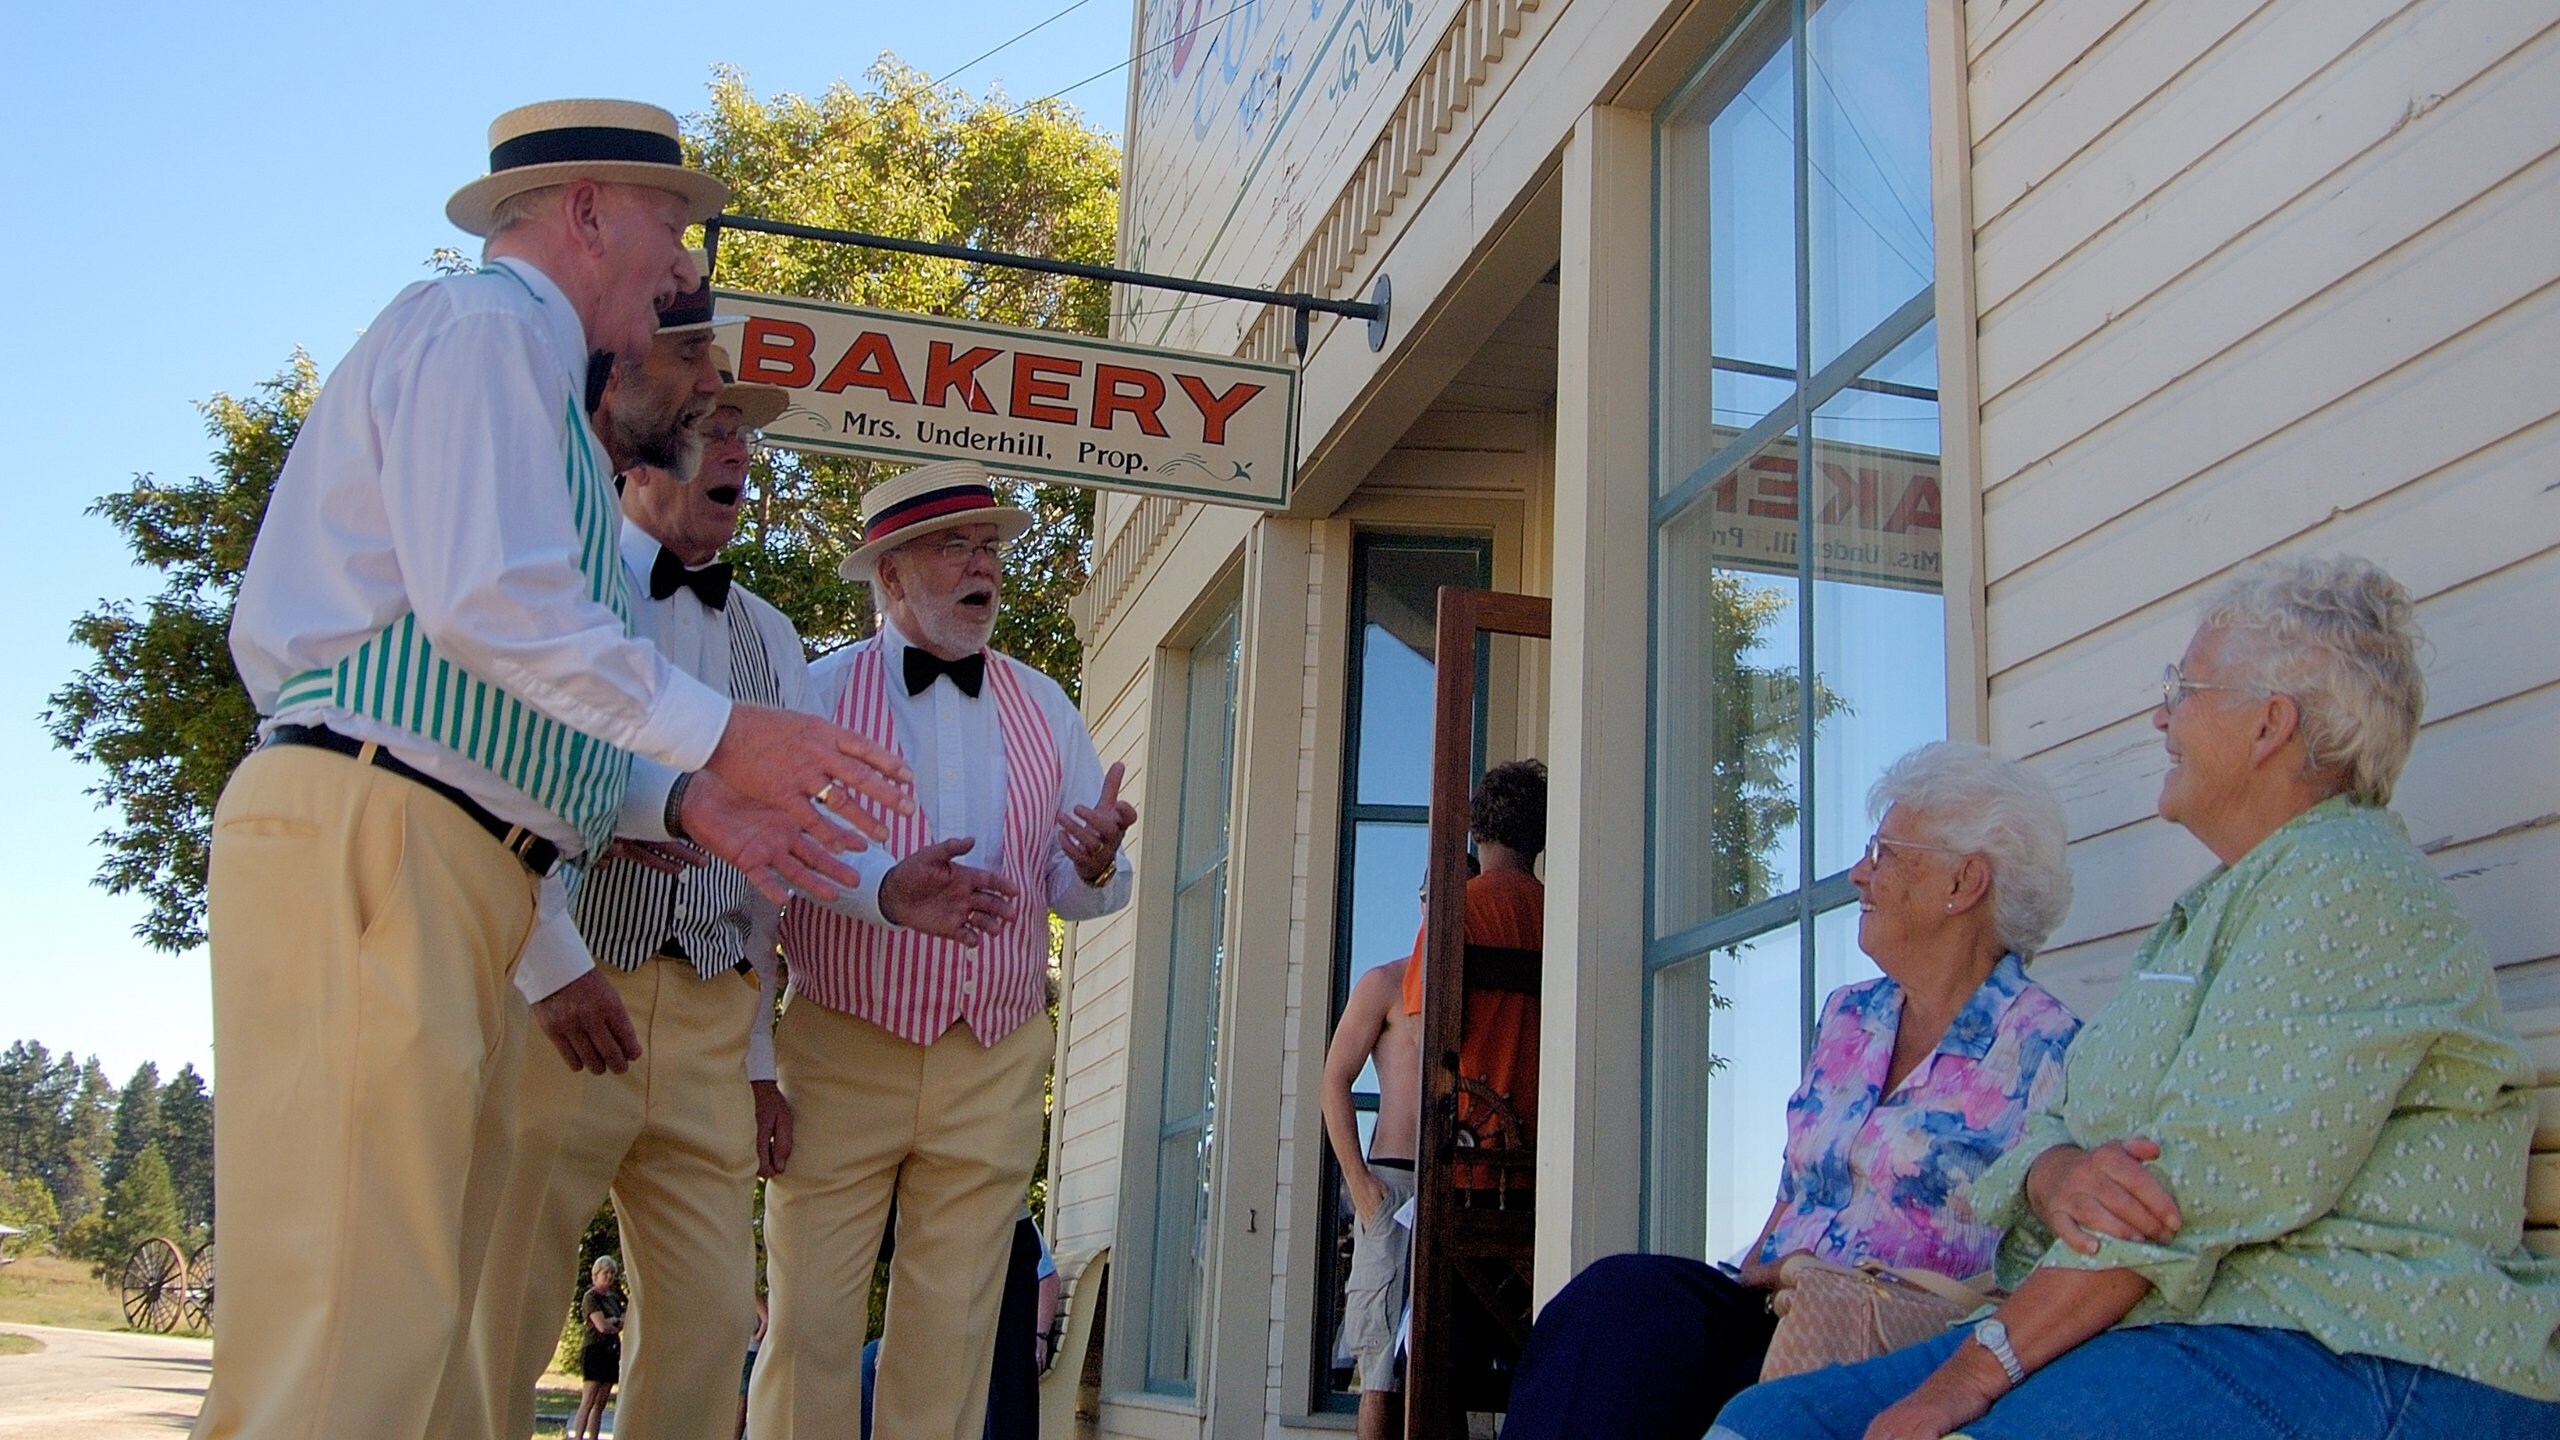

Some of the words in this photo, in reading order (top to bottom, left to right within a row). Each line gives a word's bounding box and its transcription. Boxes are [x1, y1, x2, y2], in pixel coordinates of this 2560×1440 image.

[738, 316, 1265, 446] BAKERY
[842, 410, 900, 440] Mrs.
[917, 420, 1052, 460] Underhill,
[1078, 441, 1148, 475] Prop.
